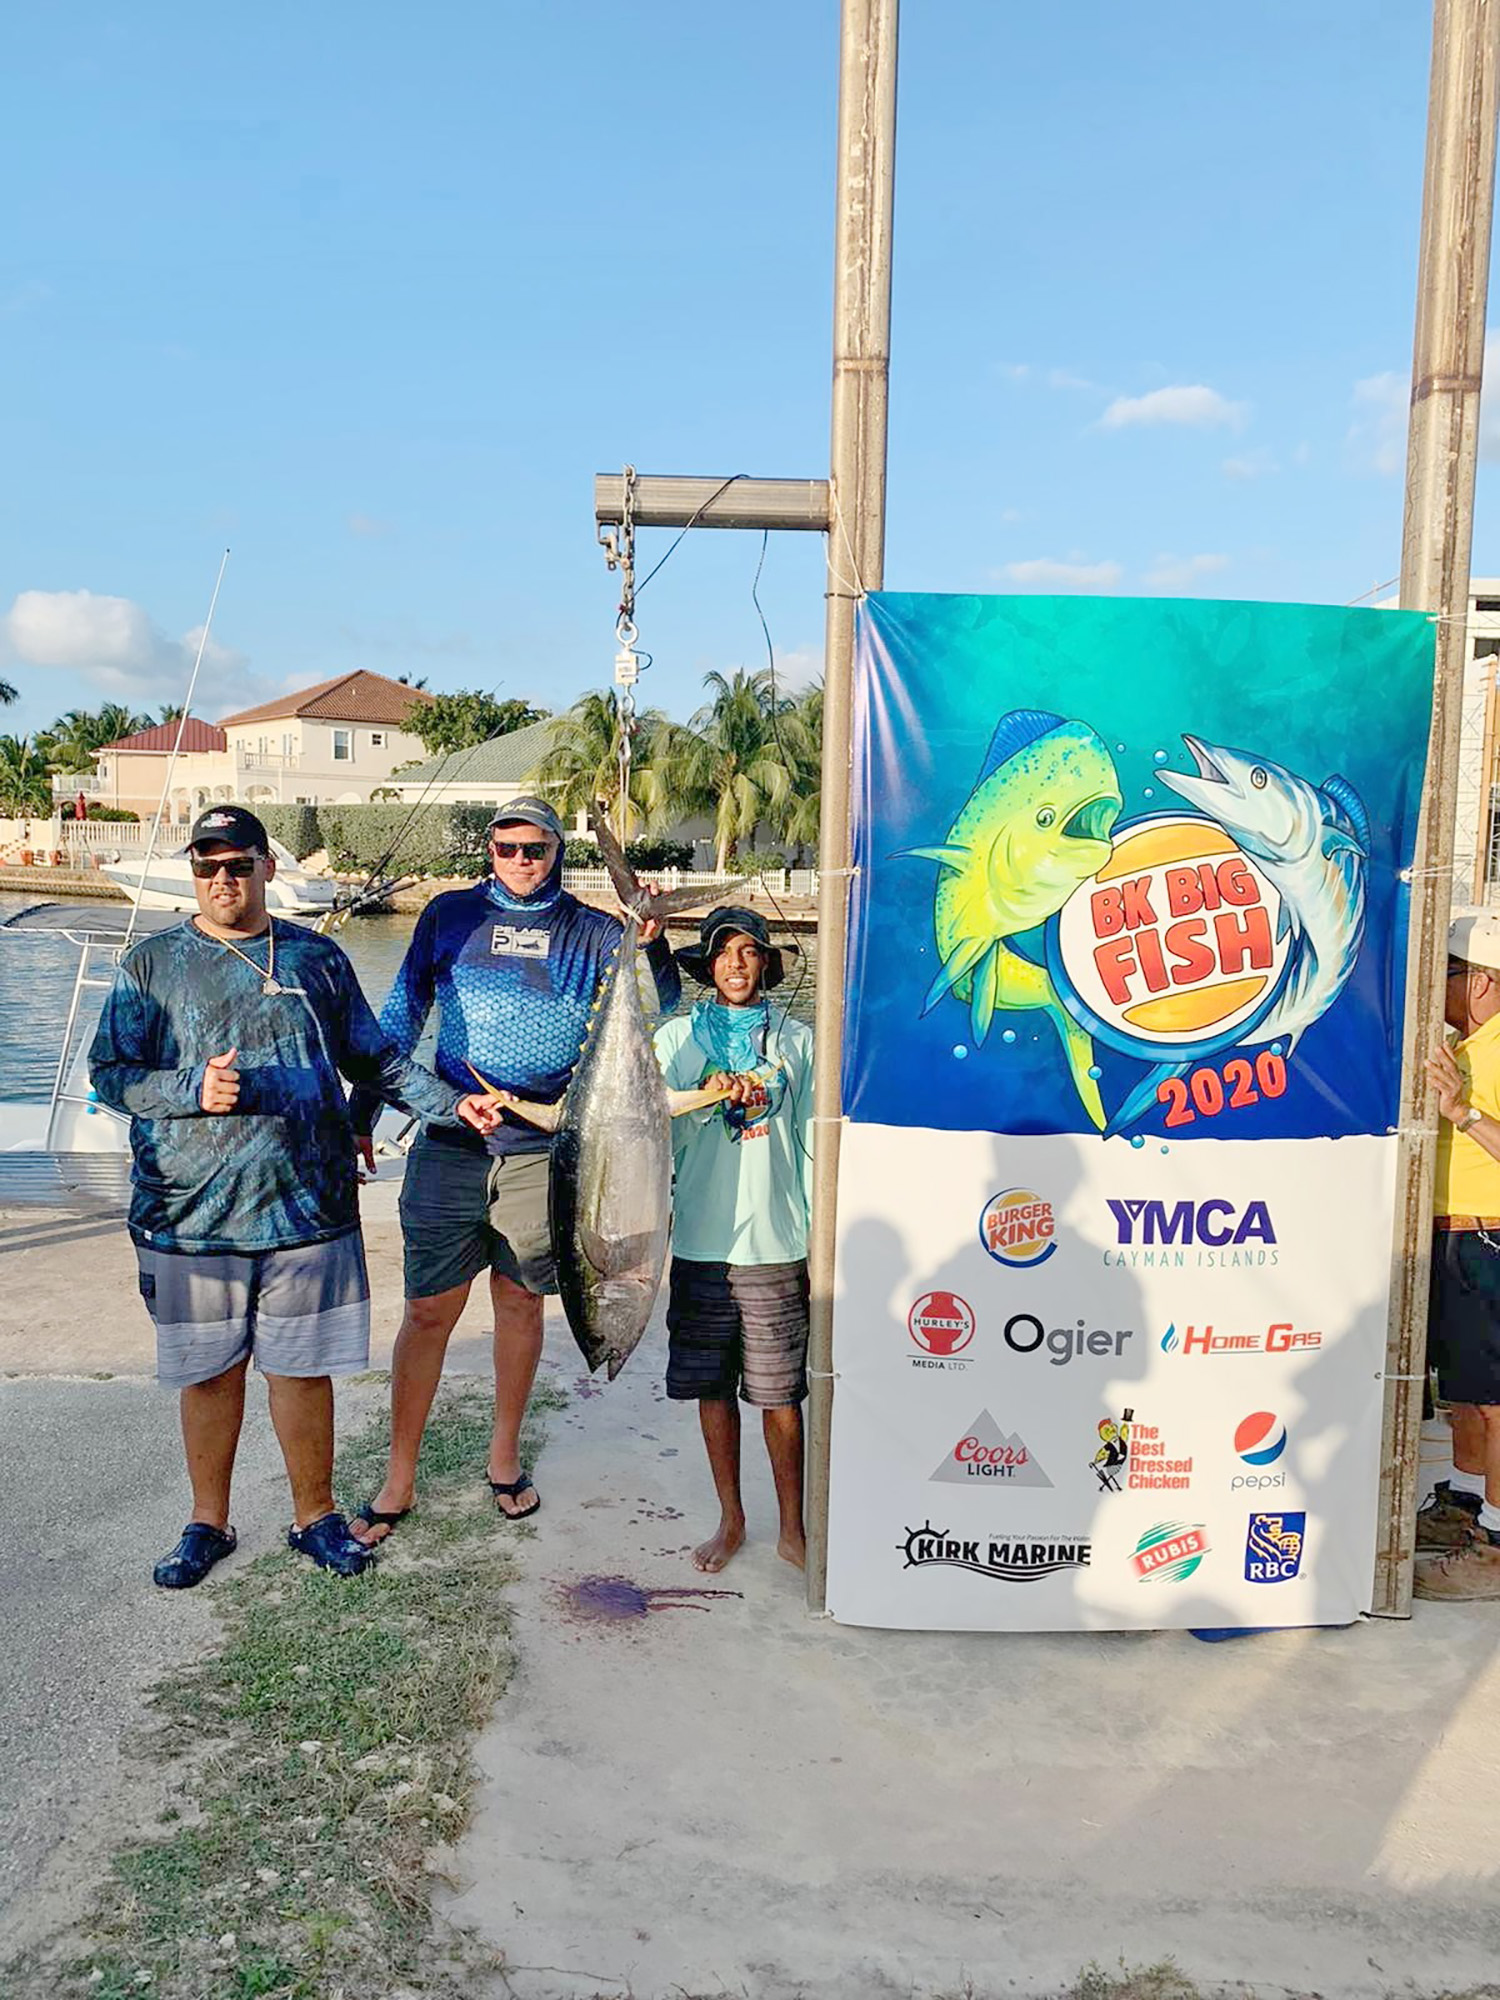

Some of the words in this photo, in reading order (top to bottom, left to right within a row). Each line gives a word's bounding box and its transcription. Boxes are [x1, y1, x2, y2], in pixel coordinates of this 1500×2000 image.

[1091, 875, 1158, 938] BK
[1166, 858, 1261, 918] BIG
[1094, 906, 1273, 1005] FISH
[1157, 1049, 1287, 1128] 2020
[742, 1124, 770, 1140] 2020
[987, 1203, 1053, 1230] BURGER
[1106, 1199, 1277, 1246] YMCA
[989, 1217, 1055, 1251] KING
[1103, 1250, 1184, 1267] CAYMAN
[1198, 1250, 1279, 1267] ISLANDS
[913, 1318, 970, 1329] HURLEY'S
[1004, 1314, 1133, 1365] Ogier
[912, 1360, 945, 1369] MEDIA
[948, 1362, 968, 1371] LTD.
[1130, 1424, 1159, 1439] The
[954, 1437, 1029, 1465] Coors
[1131, 1441, 1165, 1456] Best
[967, 1464, 1014, 1477] LIGHT
[1129, 1457, 1193, 1473] Dressed
[1128, 1474, 1190, 1489] Chicken
[1231, 1472, 1286, 1490] pepsi
[918, 1538, 980, 1563] KIRK
[988, 1543, 1091, 1565] MARINE
[1141, 1535, 1198, 1569] RUBIS
[1250, 1561, 1295, 1580] RBC
